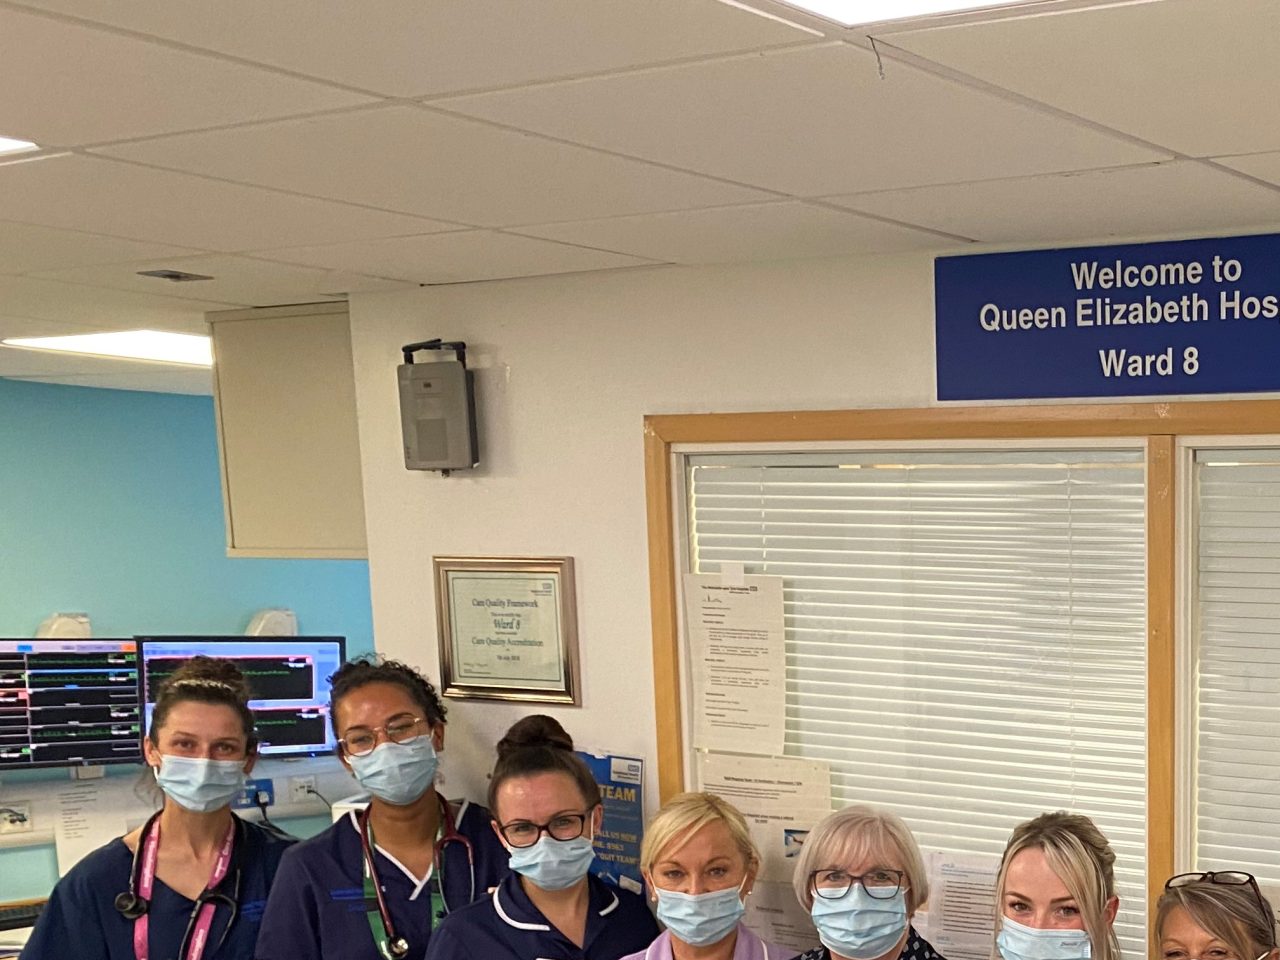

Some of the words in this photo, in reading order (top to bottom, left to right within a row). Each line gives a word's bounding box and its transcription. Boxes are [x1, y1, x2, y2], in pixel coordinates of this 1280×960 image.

[1071, 261, 1203, 290] Welcome
[1212, 255, 1242, 283] to
[980, 304, 1066, 332] Queen
[1076, 294, 1209, 327] Elizabeth
[1099, 347, 1173, 378] Ward
[1182, 346, 1199, 375] 8
[598, 784, 637, 802] TEAM
